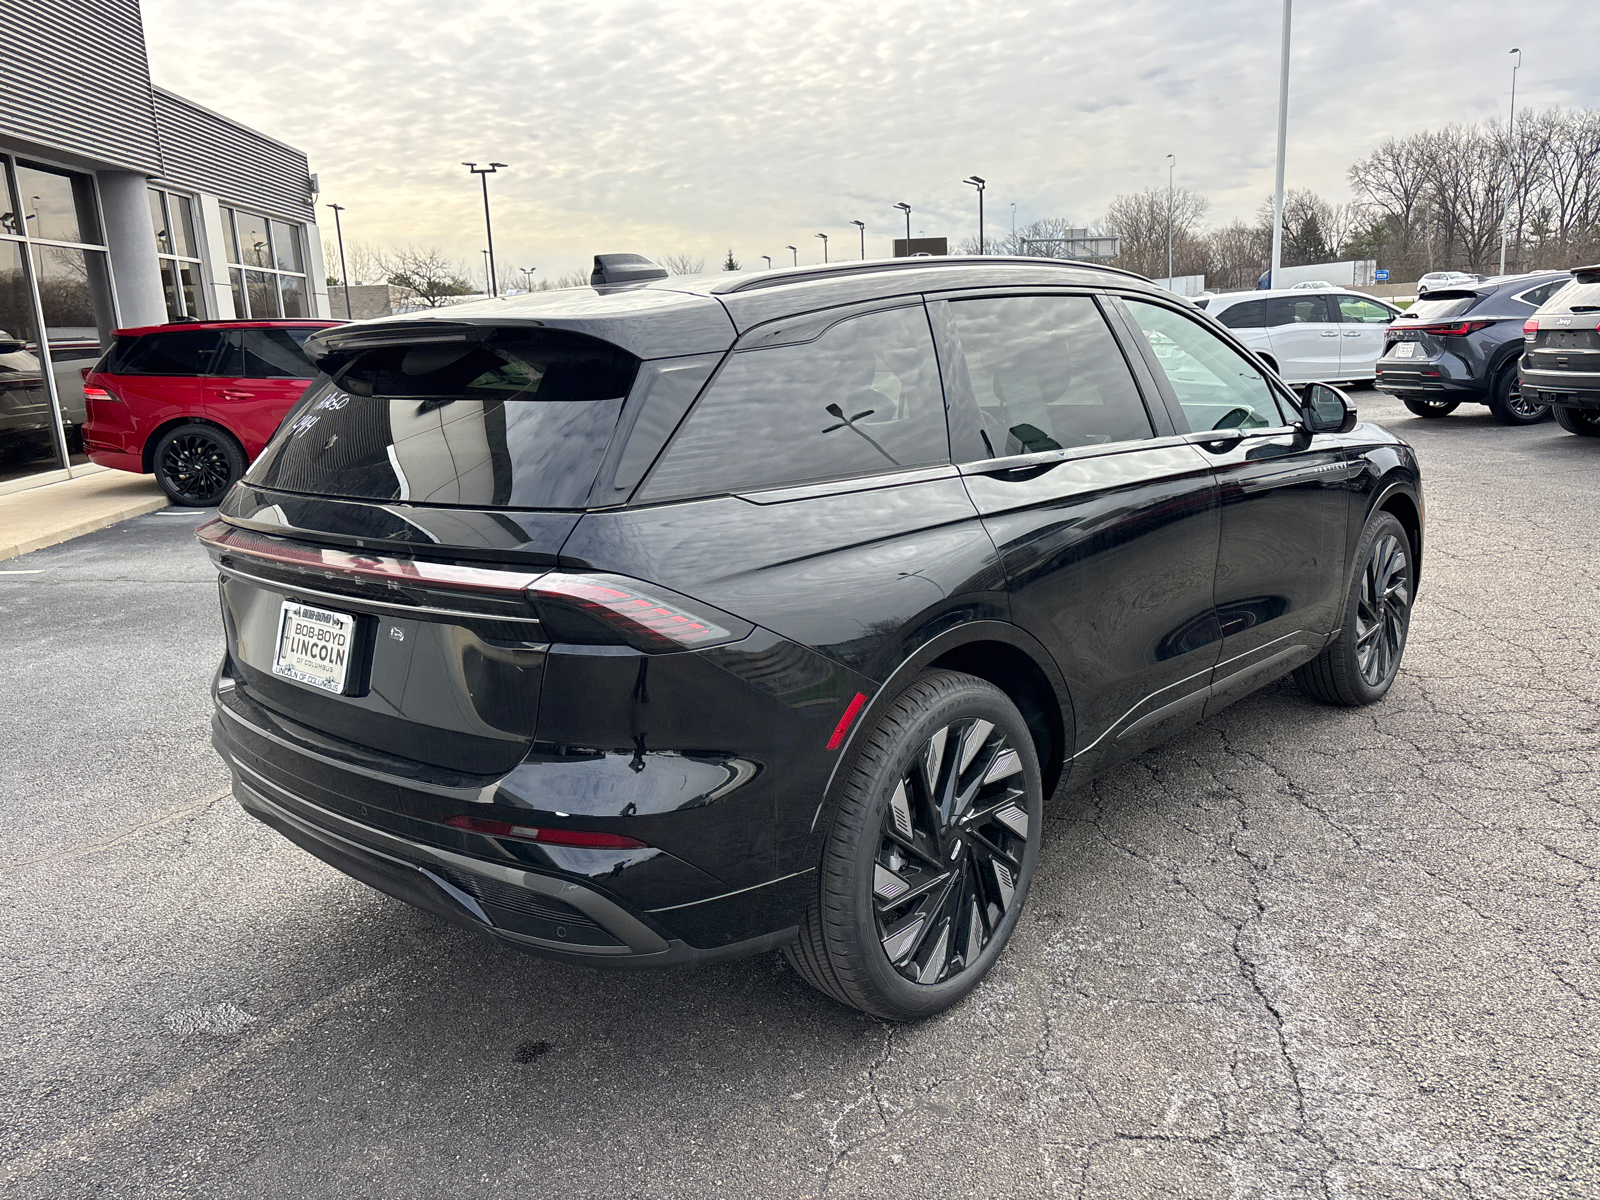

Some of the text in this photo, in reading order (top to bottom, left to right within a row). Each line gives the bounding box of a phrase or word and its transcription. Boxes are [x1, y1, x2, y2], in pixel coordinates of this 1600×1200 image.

[1557, 317, 1572, 327] Jeep
[295, 623, 346, 647] BOB-BOYD
[290, 636, 345, 667] LINCOLN
[275, 666, 299, 680] LINCOLN
[299, 672, 308, 681] OF
[304, 659, 334, 673] COLUMBUS
